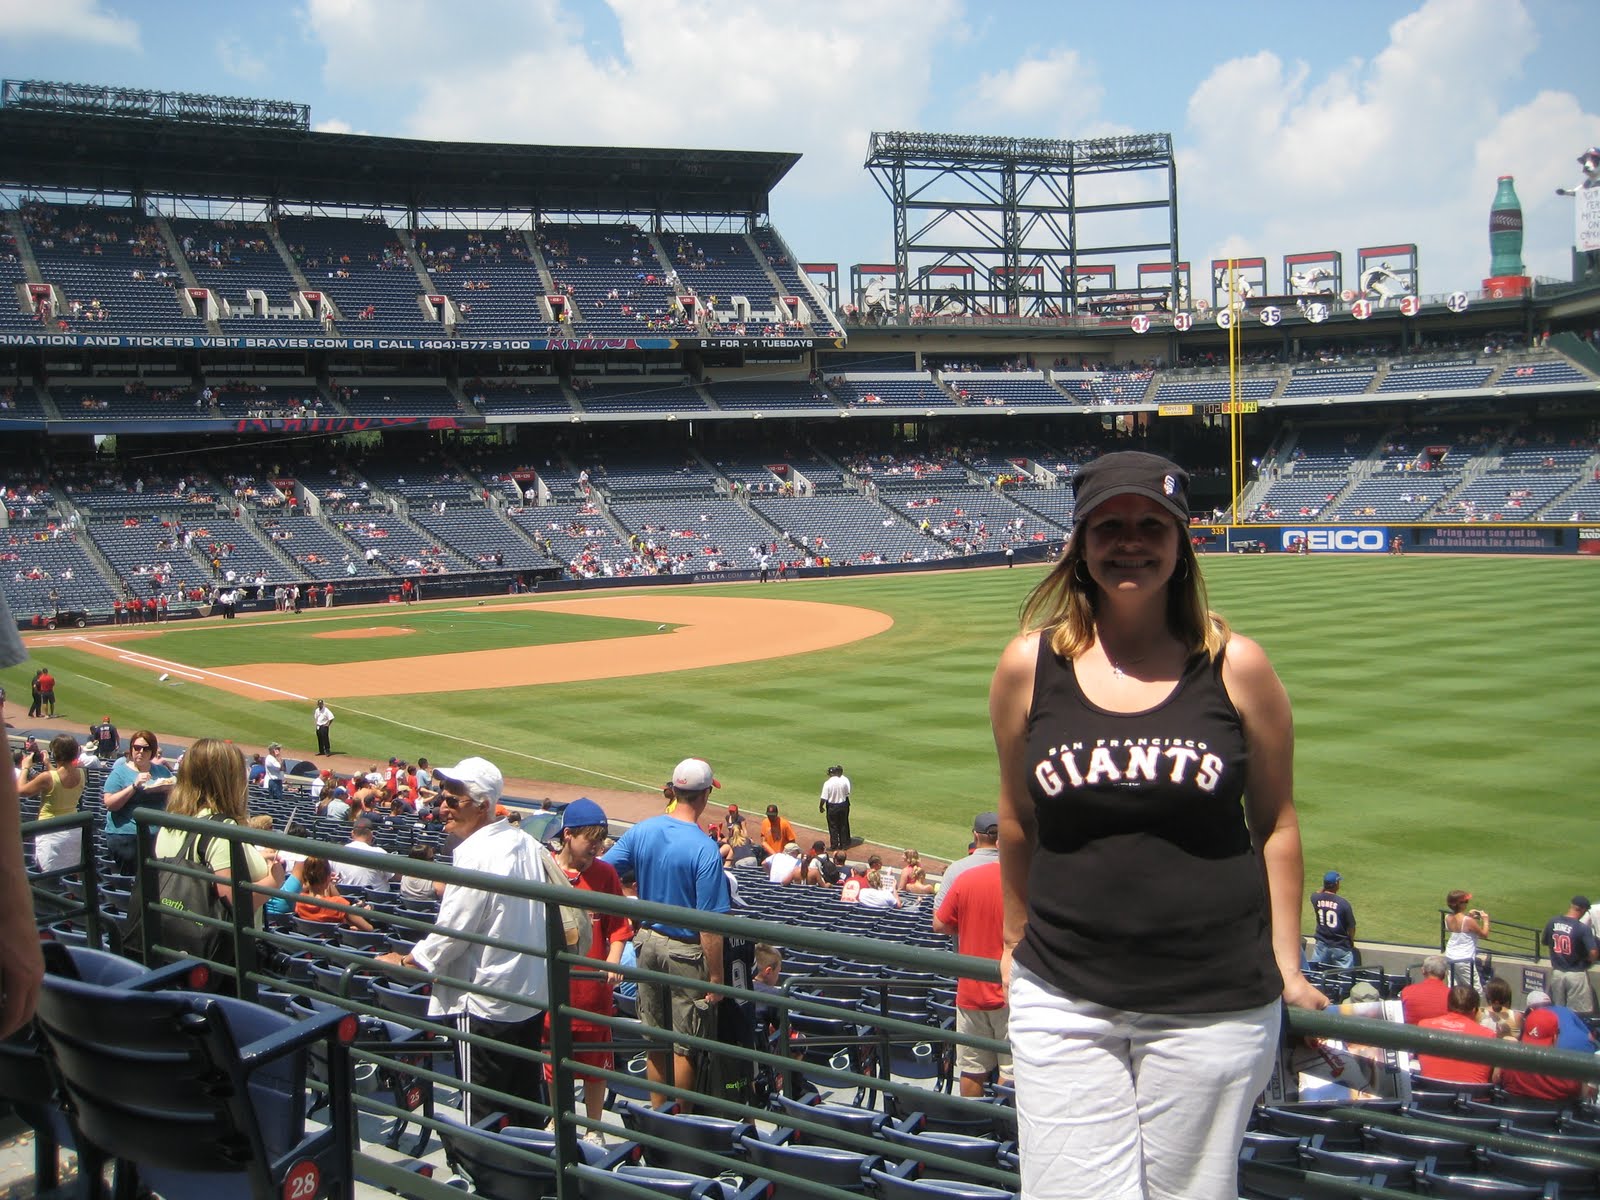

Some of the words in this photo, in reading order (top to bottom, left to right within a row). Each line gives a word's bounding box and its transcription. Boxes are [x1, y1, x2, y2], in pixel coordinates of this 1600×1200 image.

[1352, 302, 1372, 317] 41
[1400, 299, 1419, 313] 21
[1447, 295, 1468, 310] 42
[1260, 310, 1281, 322] 35
[1304, 306, 1328, 320] 44
[1131, 315, 1150, 331] 47
[1175, 315, 1192, 329] 31
[83, 336, 121, 346] AND
[126, 337, 194, 347] TICKETS
[200, 337, 240, 347] VISIT
[245, 338, 348, 348] BRAVES.COM
[353, 339, 374, 349] OR
[378, 340, 415, 349] CALL
[419, 340, 530, 350] (404)-577-9100
[700, 340, 708, 348] 2
[719, 340, 740, 348] FOR
[753, 340, 758, 348] 1
[761, 340, 813, 348] TUESDAYS
[1211, 527, 1225, 535] 335
[1436, 528, 1462, 538] Bring
[1464, 529, 1486, 538] your
[1488, 529, 1506, 537] son
[1508, 529, 1524, 537] out
[1526, 529, 1537, 537] to
[1282, 530, 1384, 550] GEICO
[701, 572, 743, 580] DELTA.COM
[1048, 742, 1083, 756] SAN
[1096, 738, 1208, 750] FRANCISCO
[1035, 746, 1224, 797] GIANTS
[161, 897, 184, 911] earth
[1317, 900, 1338, 910] JONES
[1317, 909, 1338, 928] 10
[1552, 934, 1572, 955] 10
[1528, 1026, 1539, 1037] A
[410, 1090, 420, 1104] 25
[291, 1172, 315, 1199] 28
